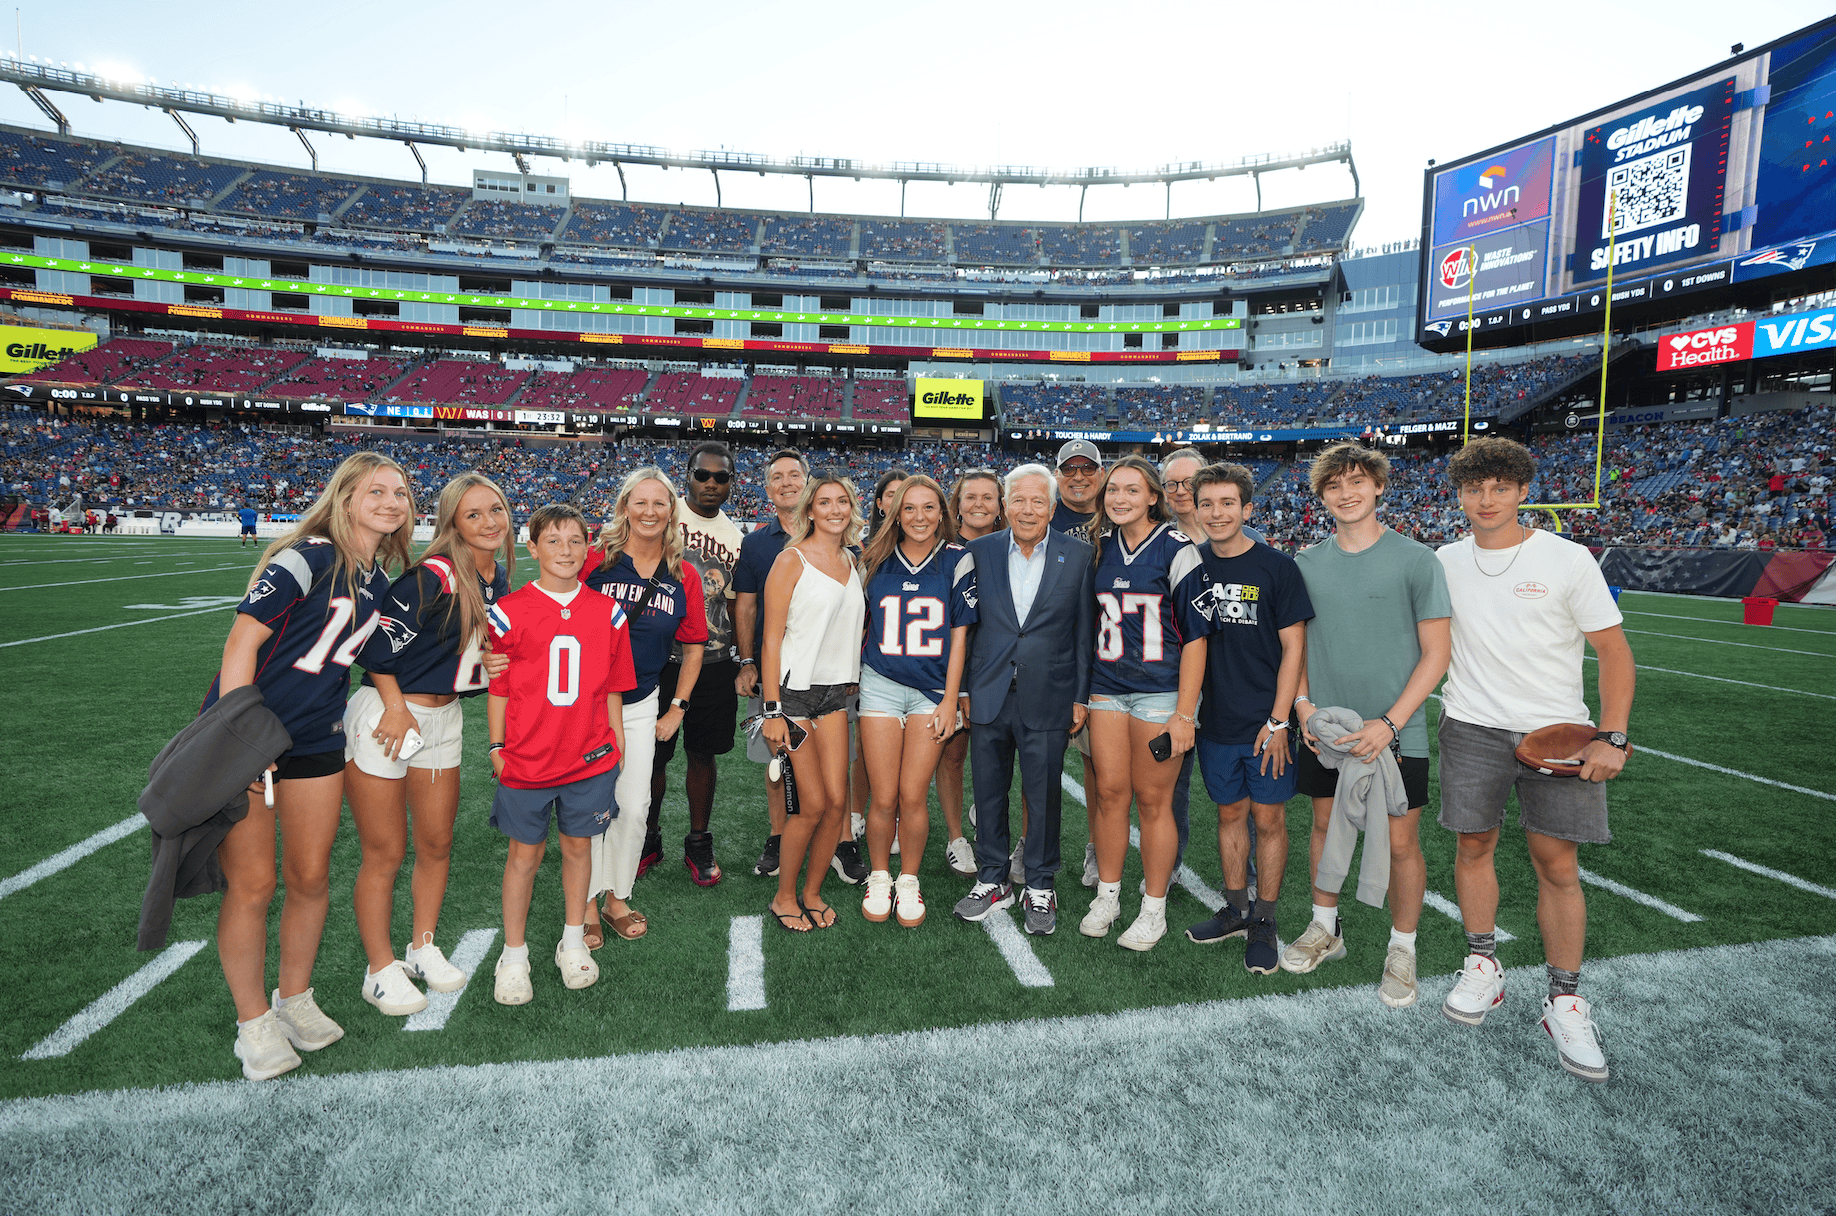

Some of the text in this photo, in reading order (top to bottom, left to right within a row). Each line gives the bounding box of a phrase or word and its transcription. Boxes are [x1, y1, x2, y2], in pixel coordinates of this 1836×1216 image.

[1607, 105, 1704, 150] Gillette
[1614, 125, 1692, 162] STADIUM
[1463, 185, 1520, 217] nwn
[1468, 211, 1516, 227] www.nwn.a
[1484, 247, 1512, 261] WASTE
[1590, 223, 1700, 271] SAFETY INFO
[1480, 251, 1534, 271] INNOVATIONS
[1663, 271, 1726, 291] 0 1ST DOWNS
[1483, 287, 1496, 299] FOR
[1497, 285, 1509, 296] THE
[1510, 281, 1535, 294] PLANET
[1590, 288, 1645, 306] 0 RUSH YDS
[1522, 303, 1570, 319] 0 PASS YDS
[318, 315, 368, 327] COMMANDERS
[1690, 327, 1737, 349] CVS
[1759, 313, 1836, 349] VIS
[6, 343, 74, 360] Gillett
[1670, 345, 1735, 367] Health
[51, 389, 77, 399] 0:00
[120, 392, 128, 402] 0
[185, 396, 193, 406] 0
[922, 391, 975, 406] Gillette
[243, 400, 251, 409] 0
[386, 405, 420, 415] NE 0
[466, 409, 489, 420] WAS
[497, 410, 503, 420] 0
[537, 413, 561, 421] 23:32
[588, 414, 598, 423] 10
[626, 416, 637, 425] 30
[1609, 411, 1664, 425] BEACON
[727, 420, 746, 429] 0:00
[776, 421, 783, 430] 0
[825, 423, 832, 431] 0
[871, 424, 878, 433] 0
[1400, 421, 1457, 433] FELGER & MAZZ
[1054, 431, 1111, 440] TOUCHER & HARDY
[1189, 432, 1253, 441] ZOLAK & BERTRAND
[600, 582, 675, 616] NEW ENLAND
[878, 595, 945, 656] 12
[1096, 592, 1164, 662] 87
[546, 635, 581, 707] 0
[784, 765, 794, 813] lululemon
